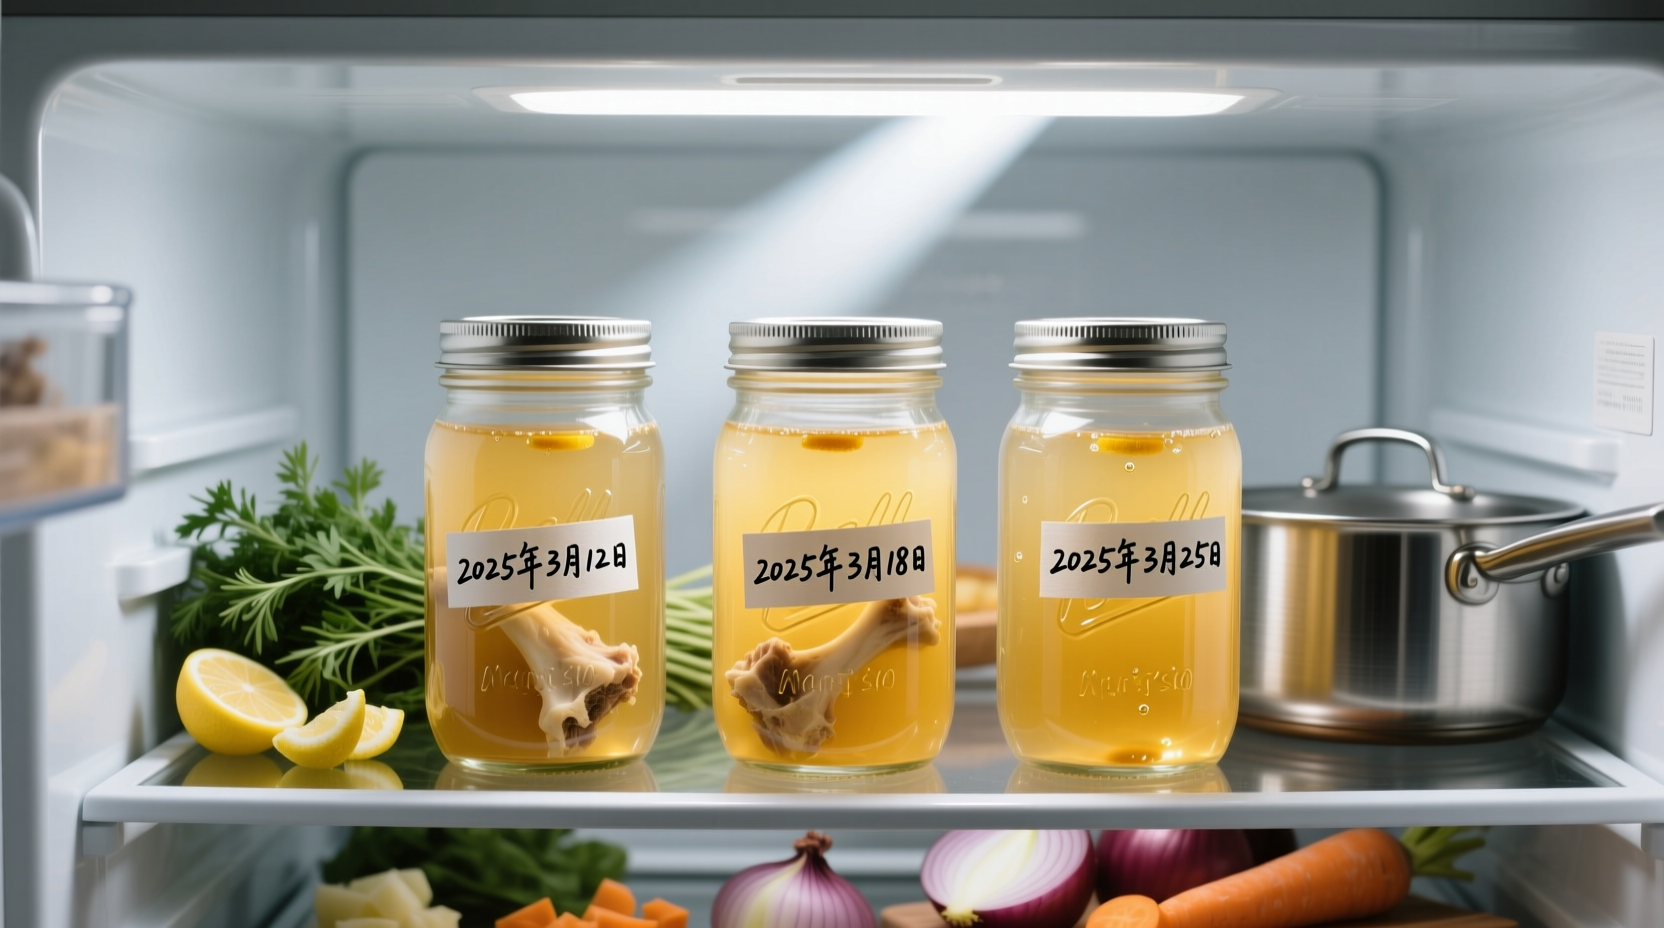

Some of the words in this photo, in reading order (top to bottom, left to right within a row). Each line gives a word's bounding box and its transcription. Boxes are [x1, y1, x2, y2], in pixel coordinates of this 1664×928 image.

[457, 542, 626, 590] 2025年3月12日
[754, 543, 925, 592] 2025年3月18日
[1050, 538, 1221, 584] 2025年3月25日
